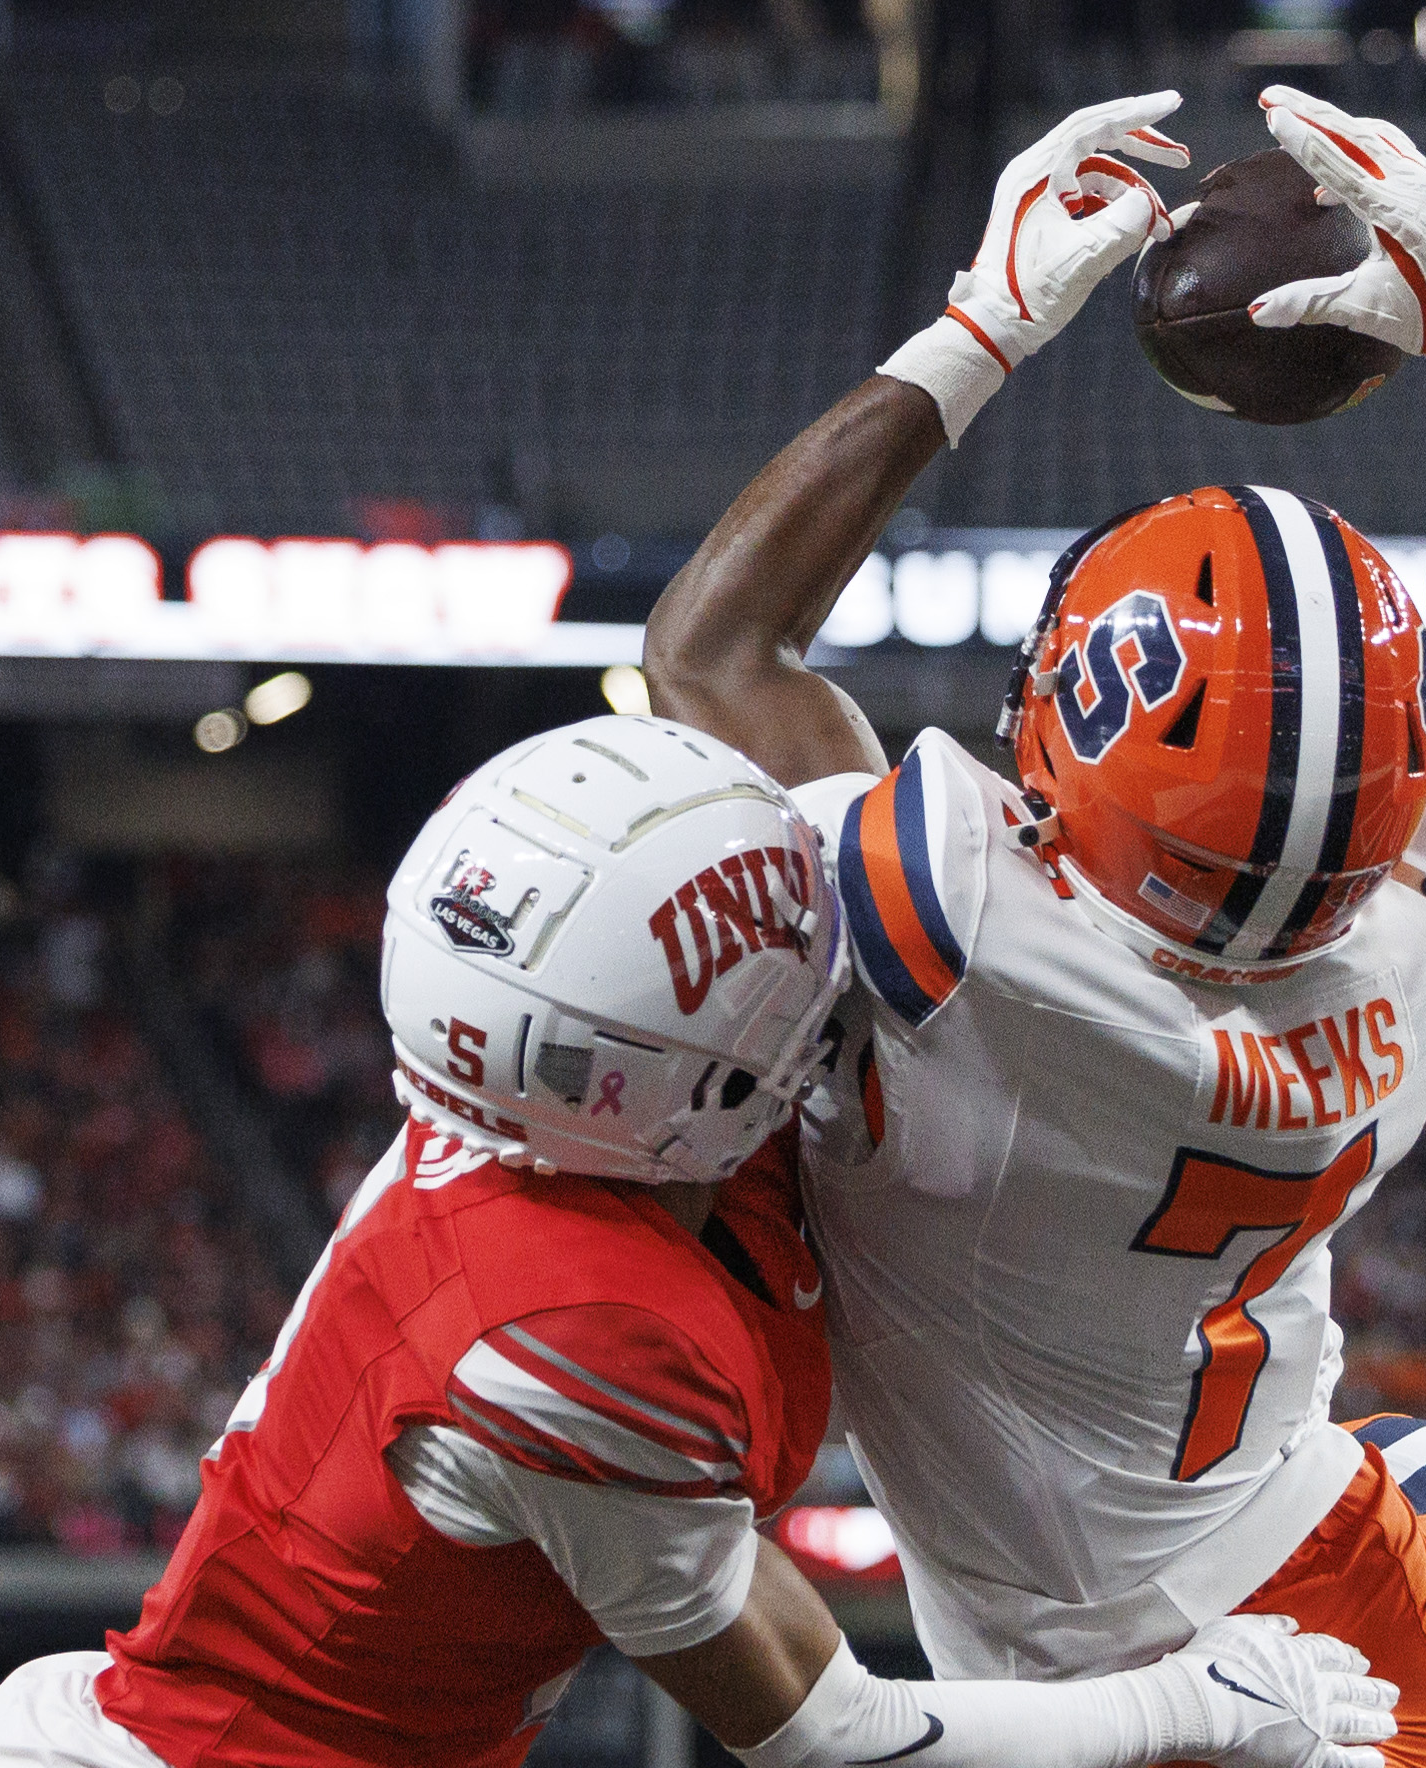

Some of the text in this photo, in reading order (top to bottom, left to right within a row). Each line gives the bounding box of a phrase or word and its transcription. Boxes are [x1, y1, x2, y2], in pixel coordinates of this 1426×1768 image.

[433, 902, 458, 924] LAS
[456, 915, 500, 949] VEGAS
[1207, 997, 1405, 1131] MEEKS
[1128, 1118, 1380, 1484] 7
